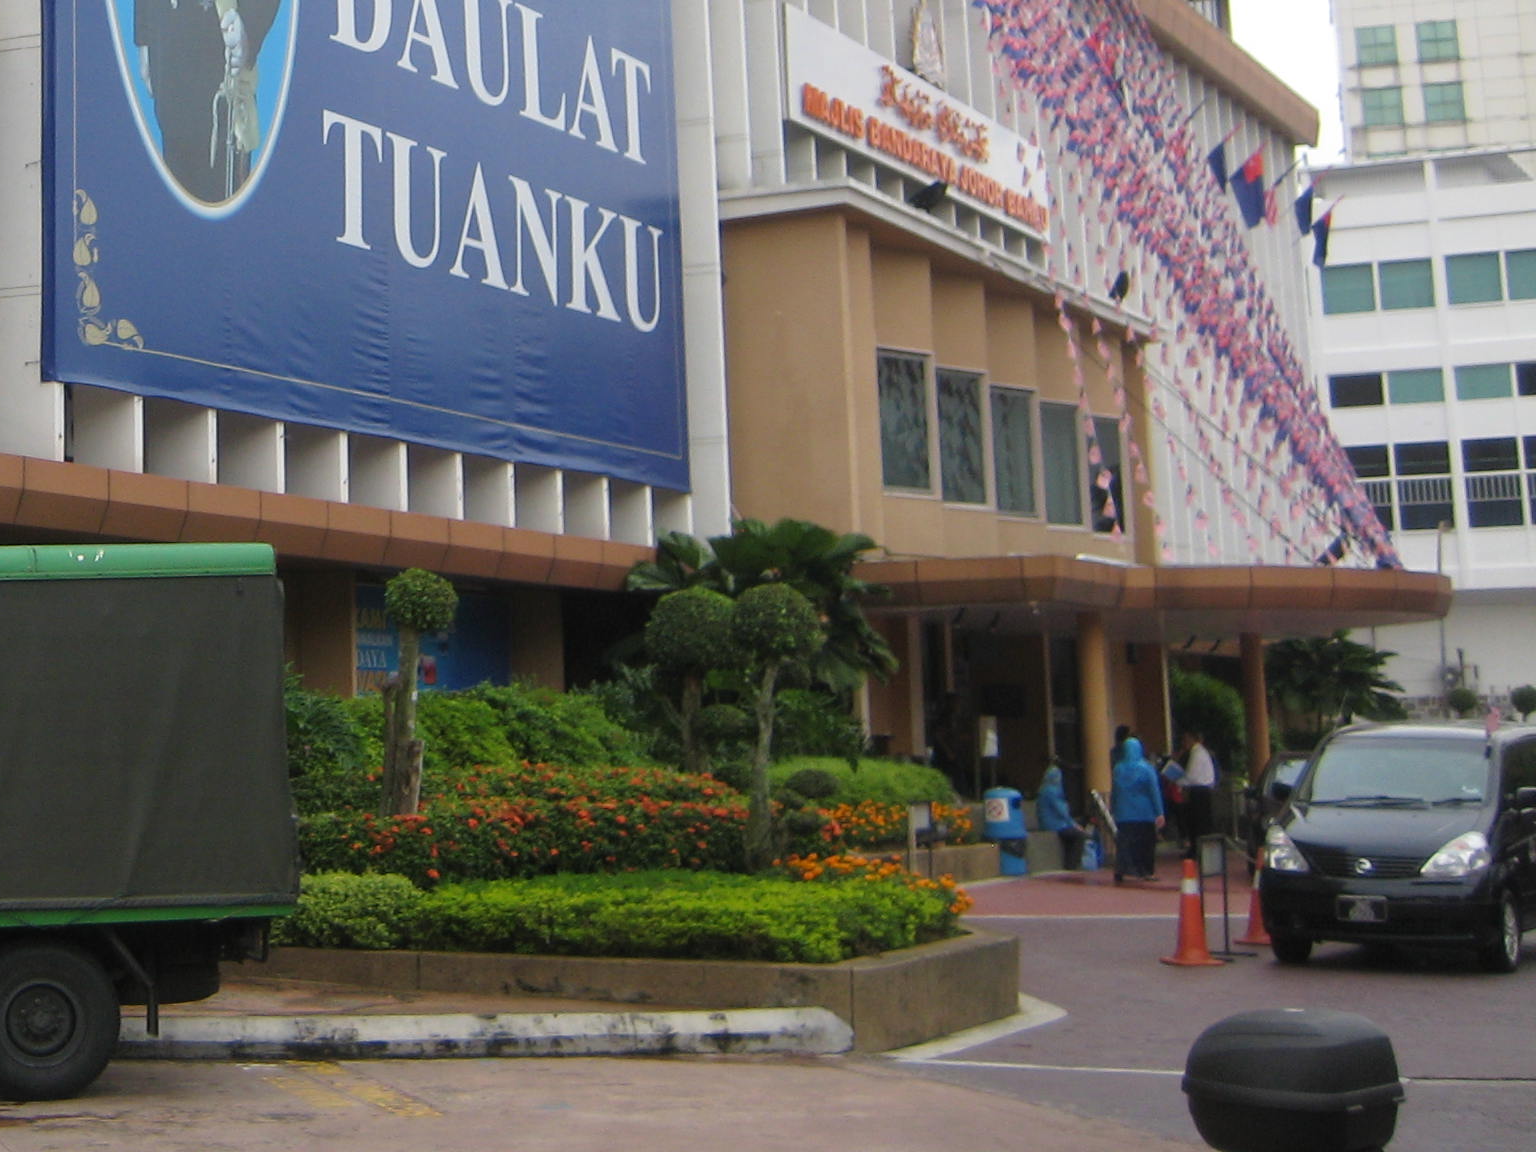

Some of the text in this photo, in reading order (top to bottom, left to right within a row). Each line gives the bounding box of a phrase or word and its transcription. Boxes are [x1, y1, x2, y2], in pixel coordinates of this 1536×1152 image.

[801, 82, 864, 139] MAJLIS
[867, 115, 957, 185] BANDARAYA
[323, 108, 664, 333] TUANKU
